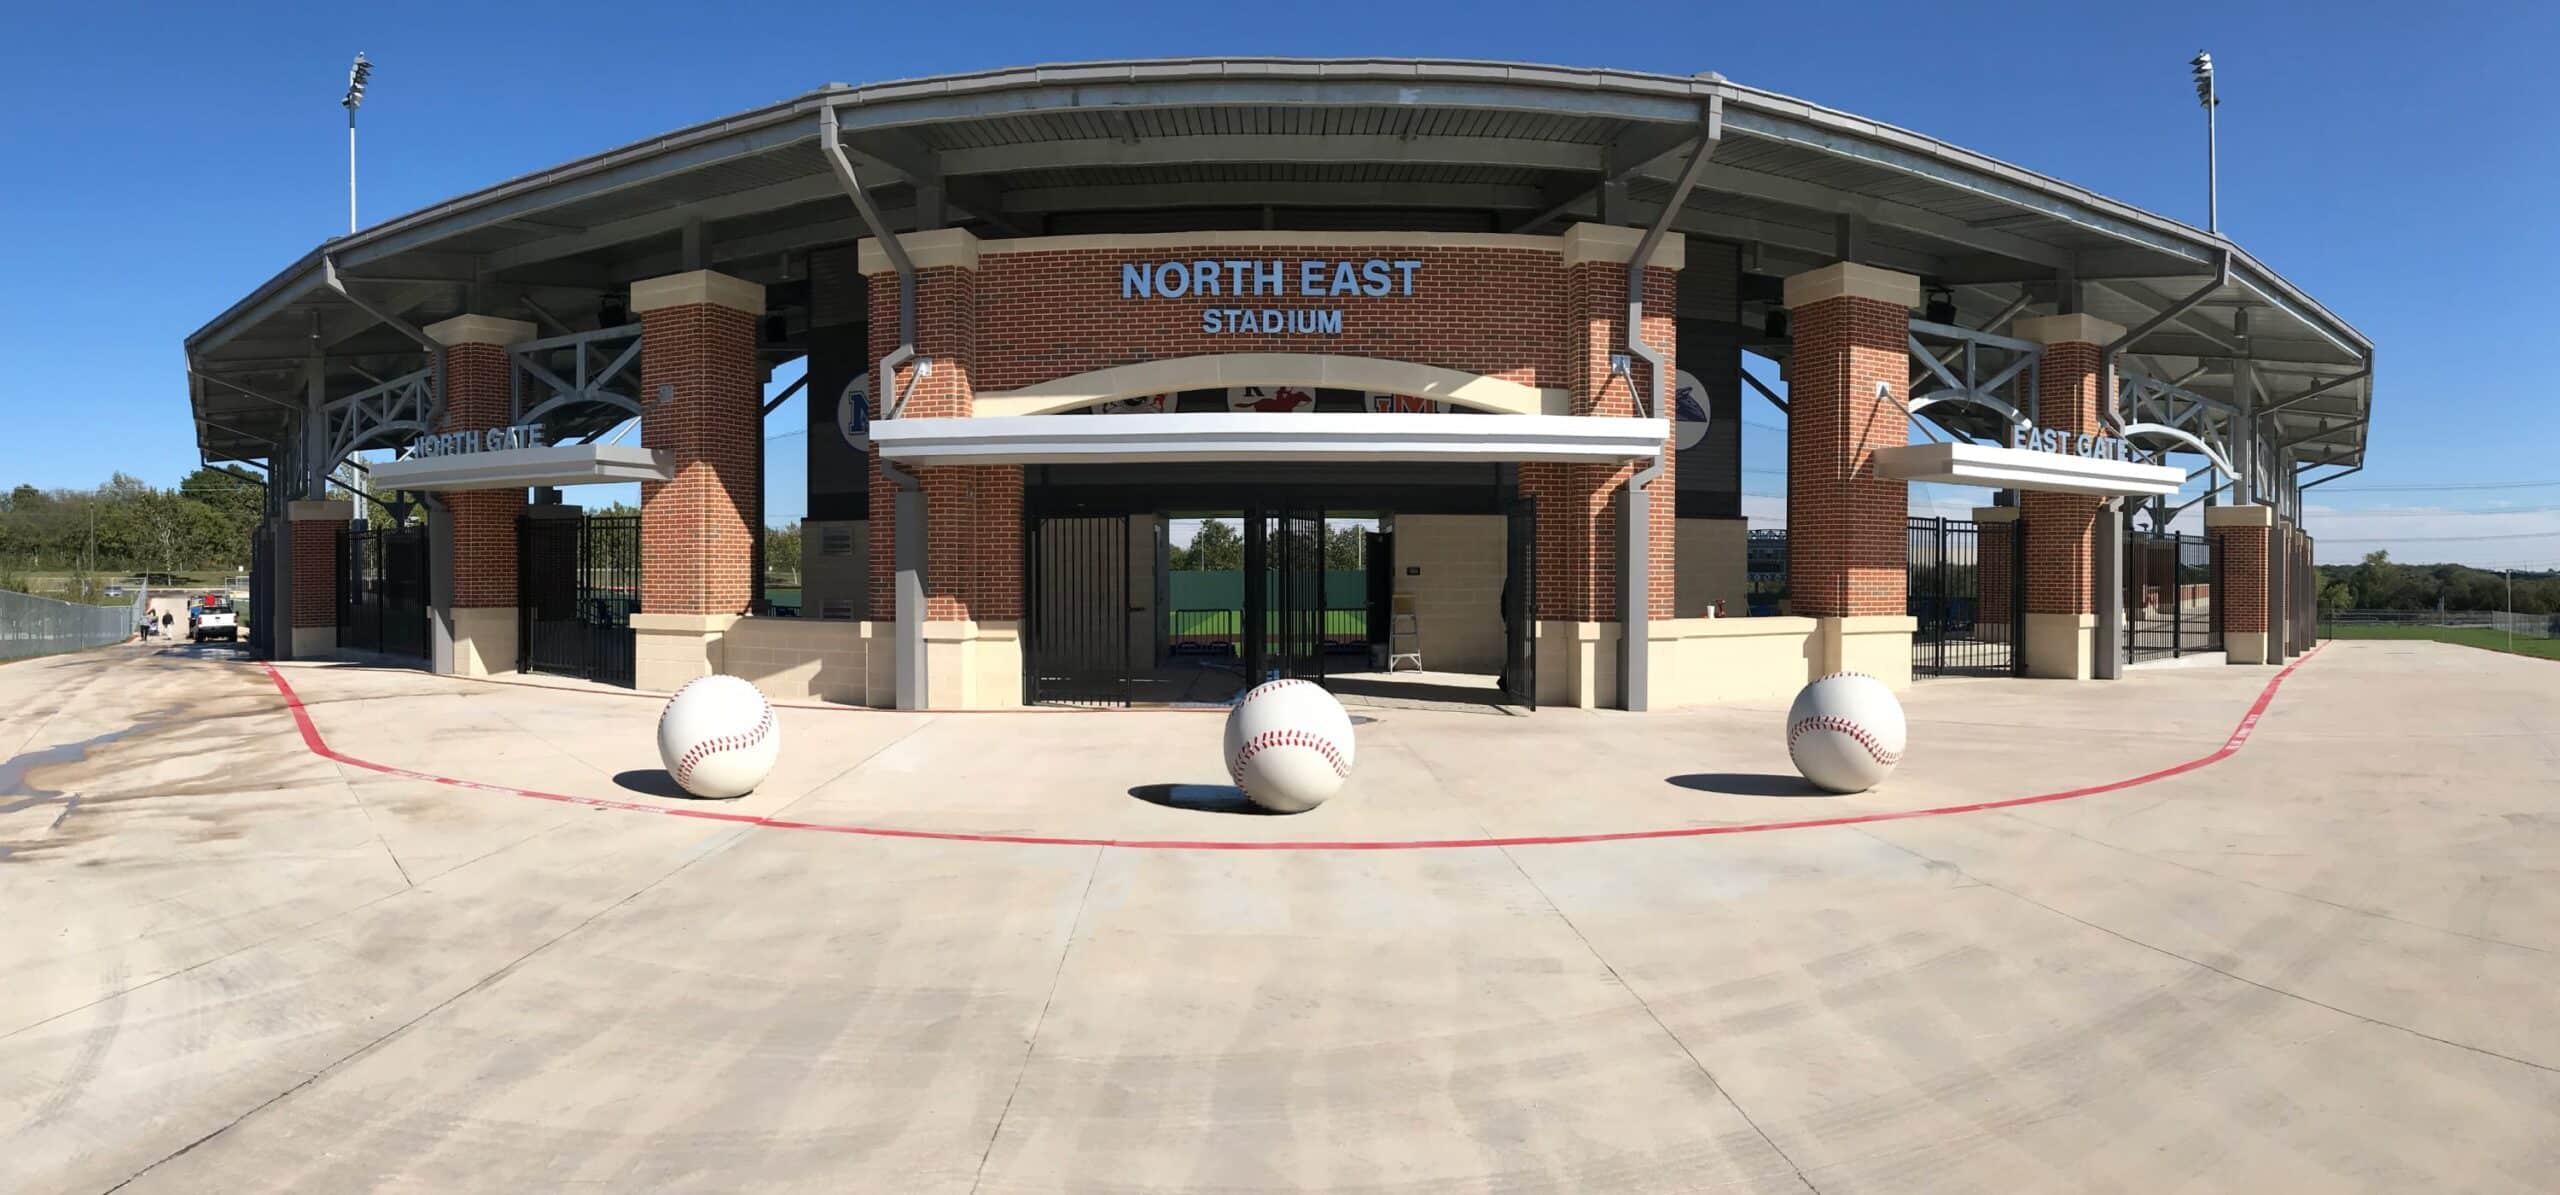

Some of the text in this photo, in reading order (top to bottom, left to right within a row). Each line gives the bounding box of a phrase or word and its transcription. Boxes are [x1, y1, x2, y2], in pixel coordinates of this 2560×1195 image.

[1121, 259, 1421, 299] NORTH EAST
[1202, 308, 1344, 334] STADIUM
[413, 424, 545, 459] NORTH GATE
[2012, 425, 2130, 462] EAST GATE
